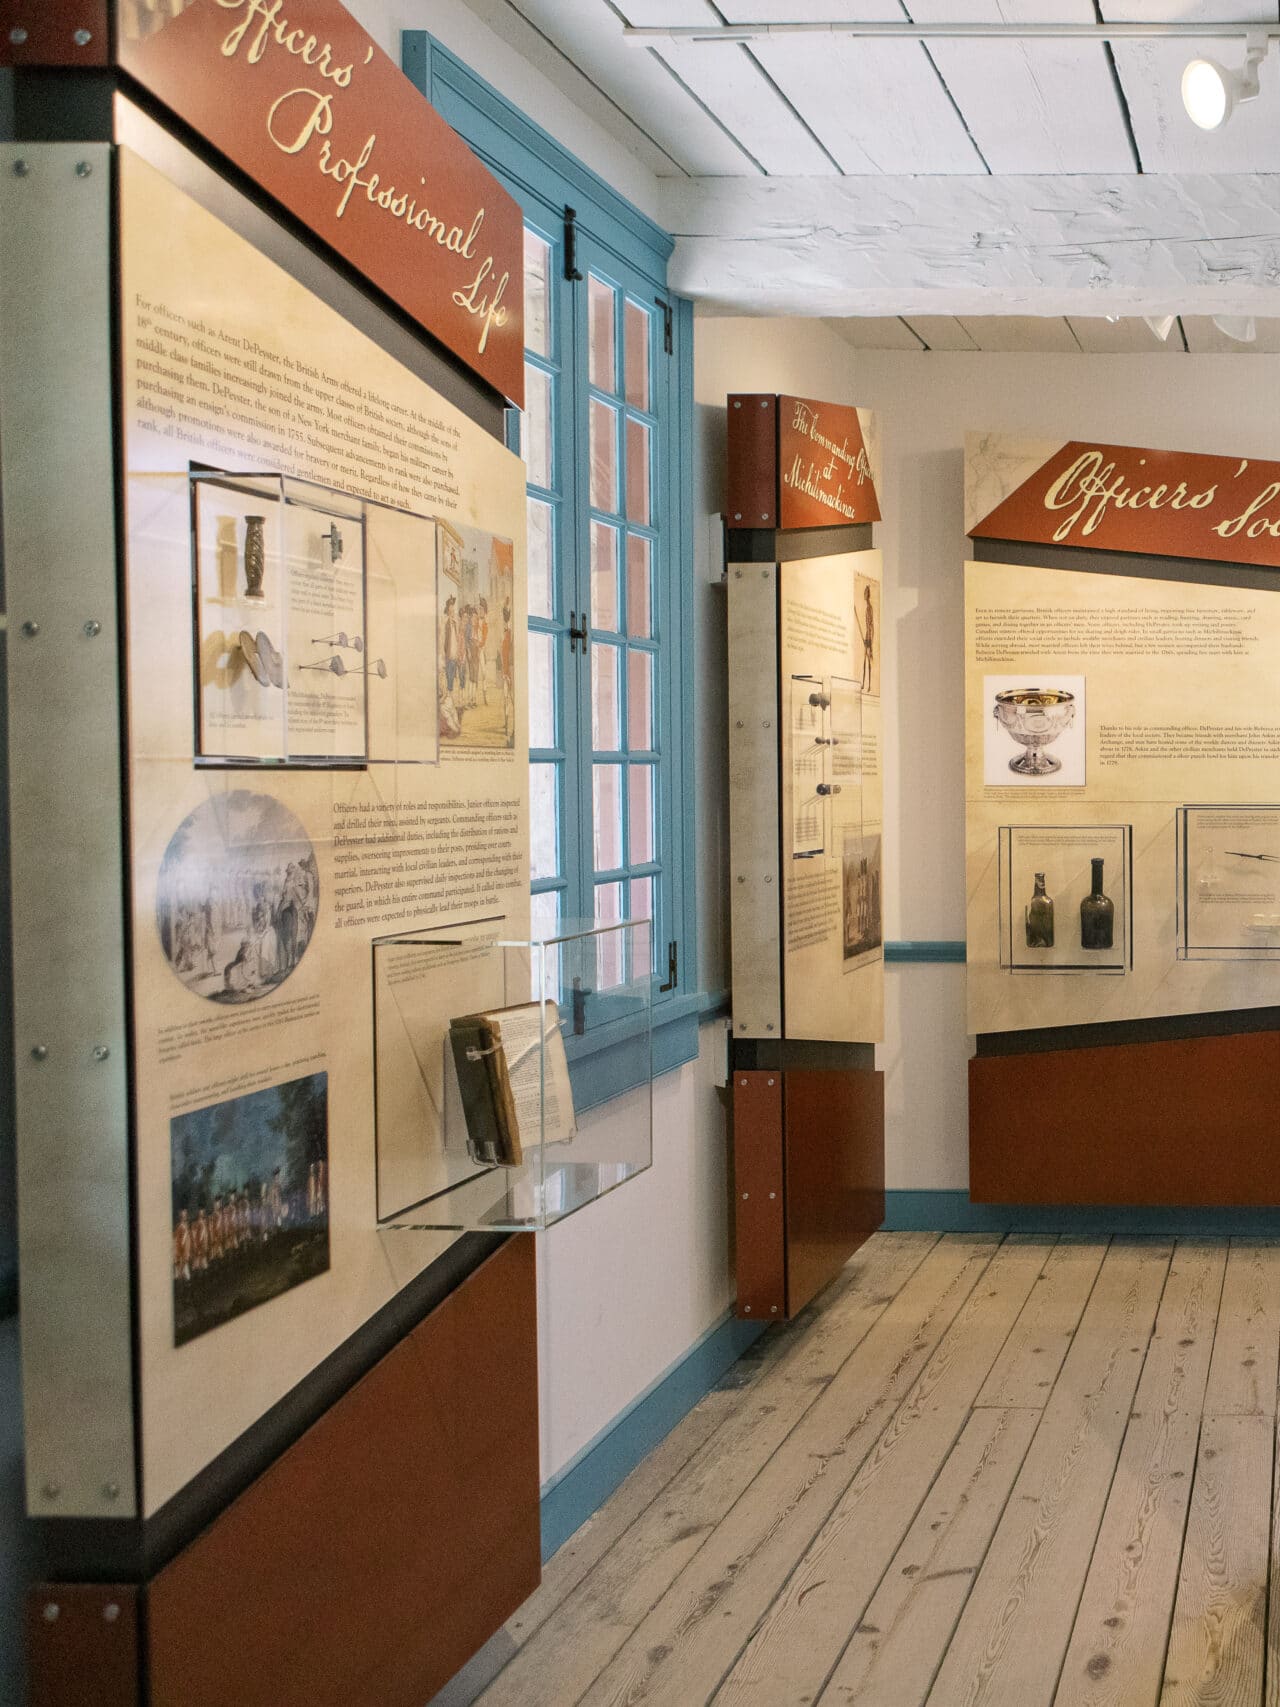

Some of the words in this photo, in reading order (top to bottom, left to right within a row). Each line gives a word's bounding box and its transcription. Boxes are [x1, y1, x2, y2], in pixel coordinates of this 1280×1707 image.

[216, 0, 373, 87] fficers'
[268, 88, 485, 259] Professional
[452, 256, 509, 354] Life
[823, 457, 838, 480] at
[1044, 451, 1248, 542] Officers'
